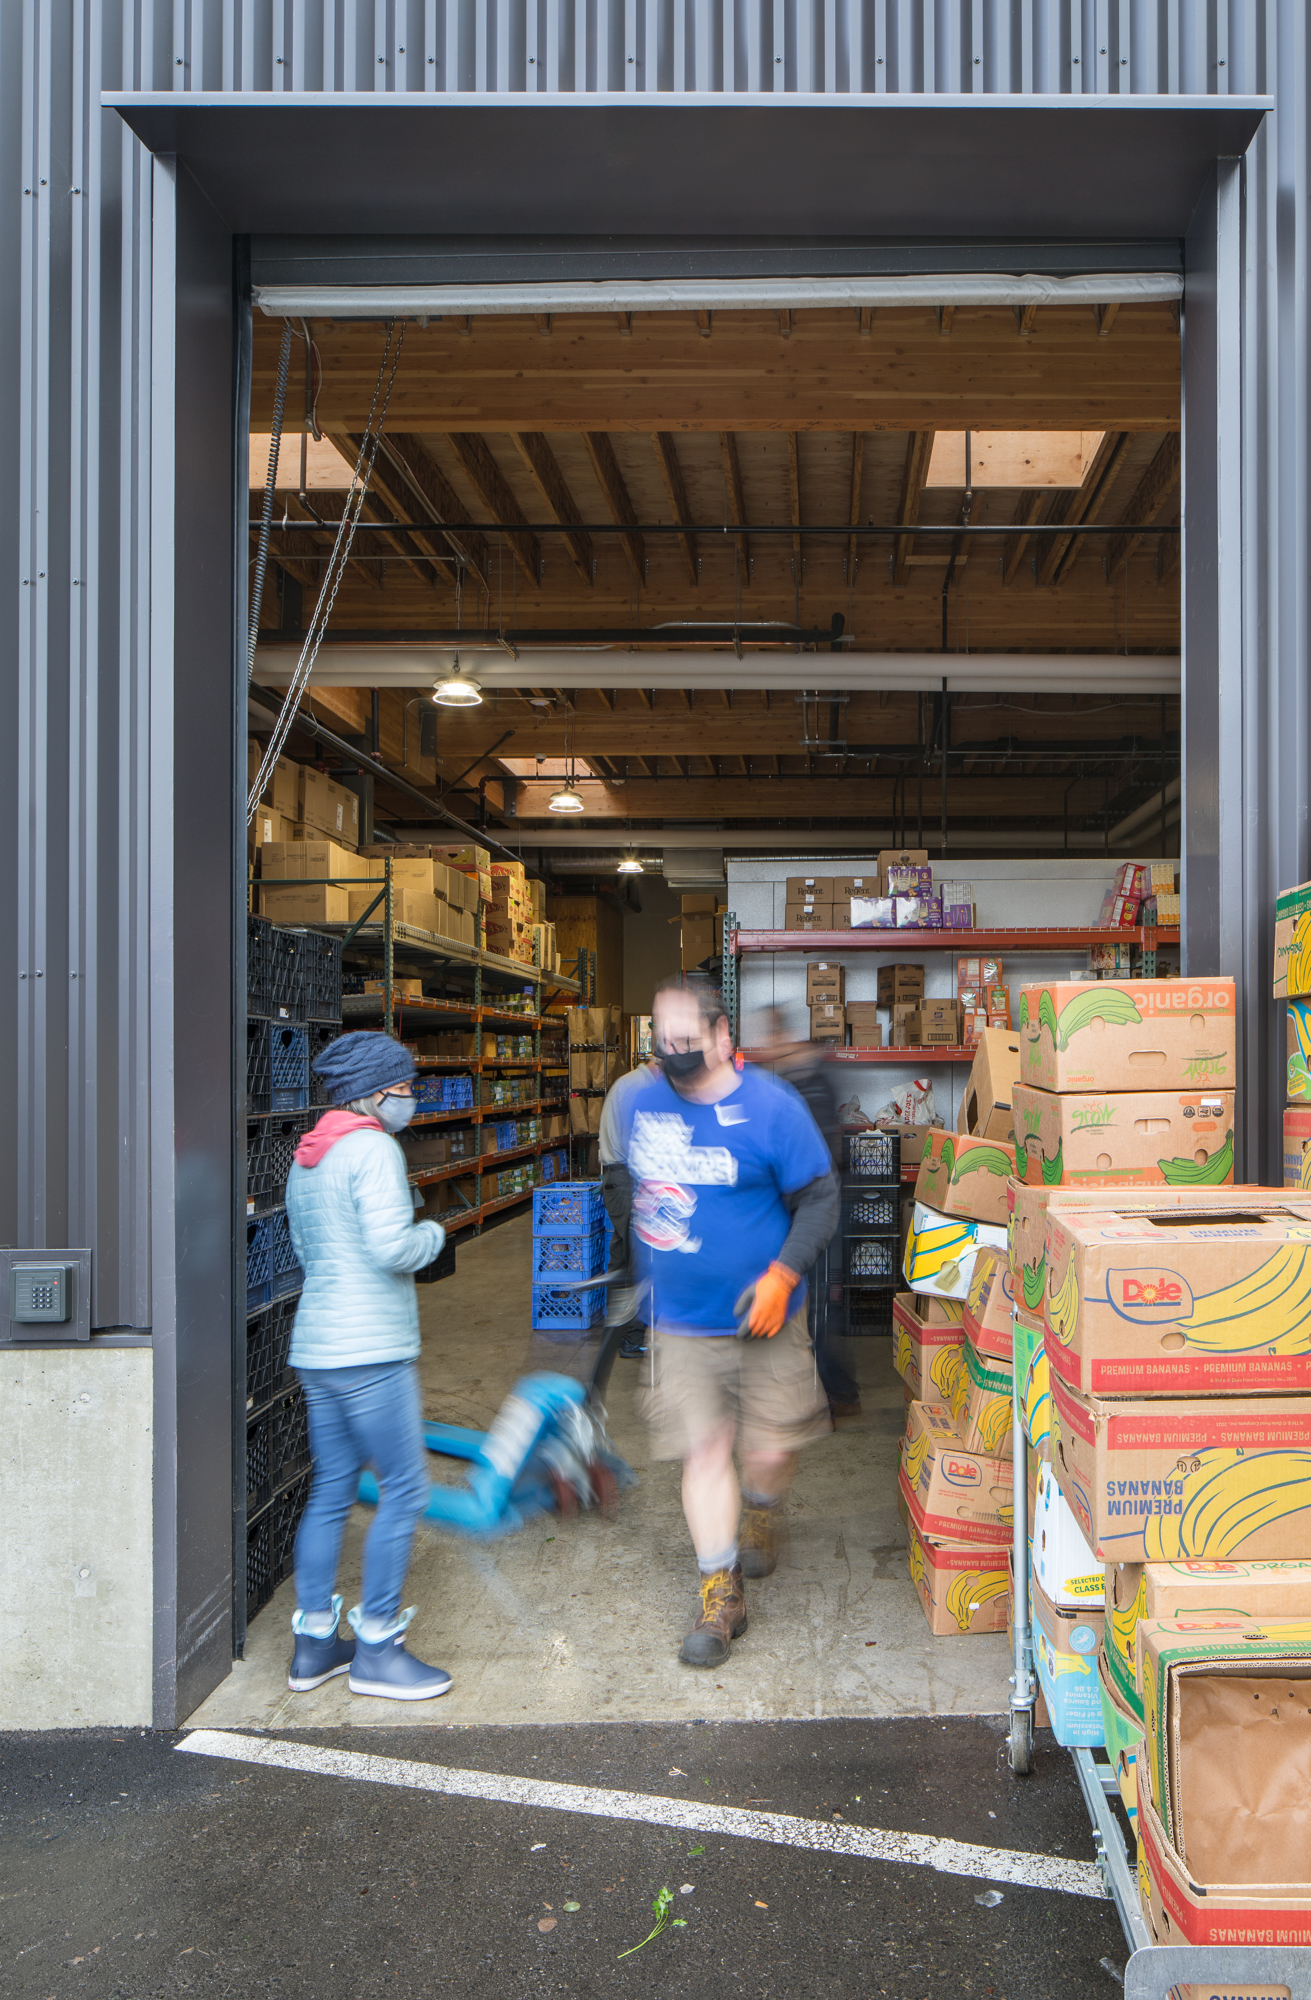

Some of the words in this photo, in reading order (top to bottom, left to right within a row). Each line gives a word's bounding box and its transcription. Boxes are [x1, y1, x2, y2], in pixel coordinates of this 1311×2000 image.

[797, 887, 824, 897] Regent
[844, 886, 871, 896] Regent
[796, 914, 823, 923] Regent
[1277, 941, 1303, 958] ORGANIC
[1133, 986, 1230, 1015] organic
[1067, 1075, 1095, 1084] organic
[1058, 1196, 1092, 1204] premium
[1122, 1278, 1183, 1305] Dole
[1101, 1365, 1144, 1376] PREMIUM
[1146, 1364, 1190, 1375] BANANAS
[1203, 1363, 1246, 1373] PREMIUM
[1249, 1361, 1292, 1372] BANANAS
[983, 1379, 1013, 1393] ANANAS
[1117, 1433, 1161, 1443] BANANAS
[1163, 1432, 1207, 1443] PREMIUM
[1220, 1432, 1265, 1442] BANANAS
[1267, 1431, 1310, 1441] PREMIUM
[948, 1461, 977, 1477] Dole
[1106, 1480, 1184, 1496] BANANAS
[1107, 1500, 1183, 1516] PREMIUM
[938, 1520, 968, 1532] PREMIUM
[968, 1525, 997, 1536] BANANAS
[1184, 1562, 1236, 1571] Dole
[1251, 1562, 1311, 1570] ORGA
[1070, 1576, 1100, 1585] SELECTED
[1074, 1584, 1100, 1593] CLASS
[1175, 1622, 1243, 1631] Dole
[1177, 1643, 1247, 1653] CERTIFIED
[1065, 1691, 1099, 1699] Vitamins
[1063, 1697, 1090, 1706] Source
[1081, 1729, 1099, 1737] High
[1209, 1928, 1274, 1943] BANANAS
[1276, 1929, 1311, 1943] MIUM
